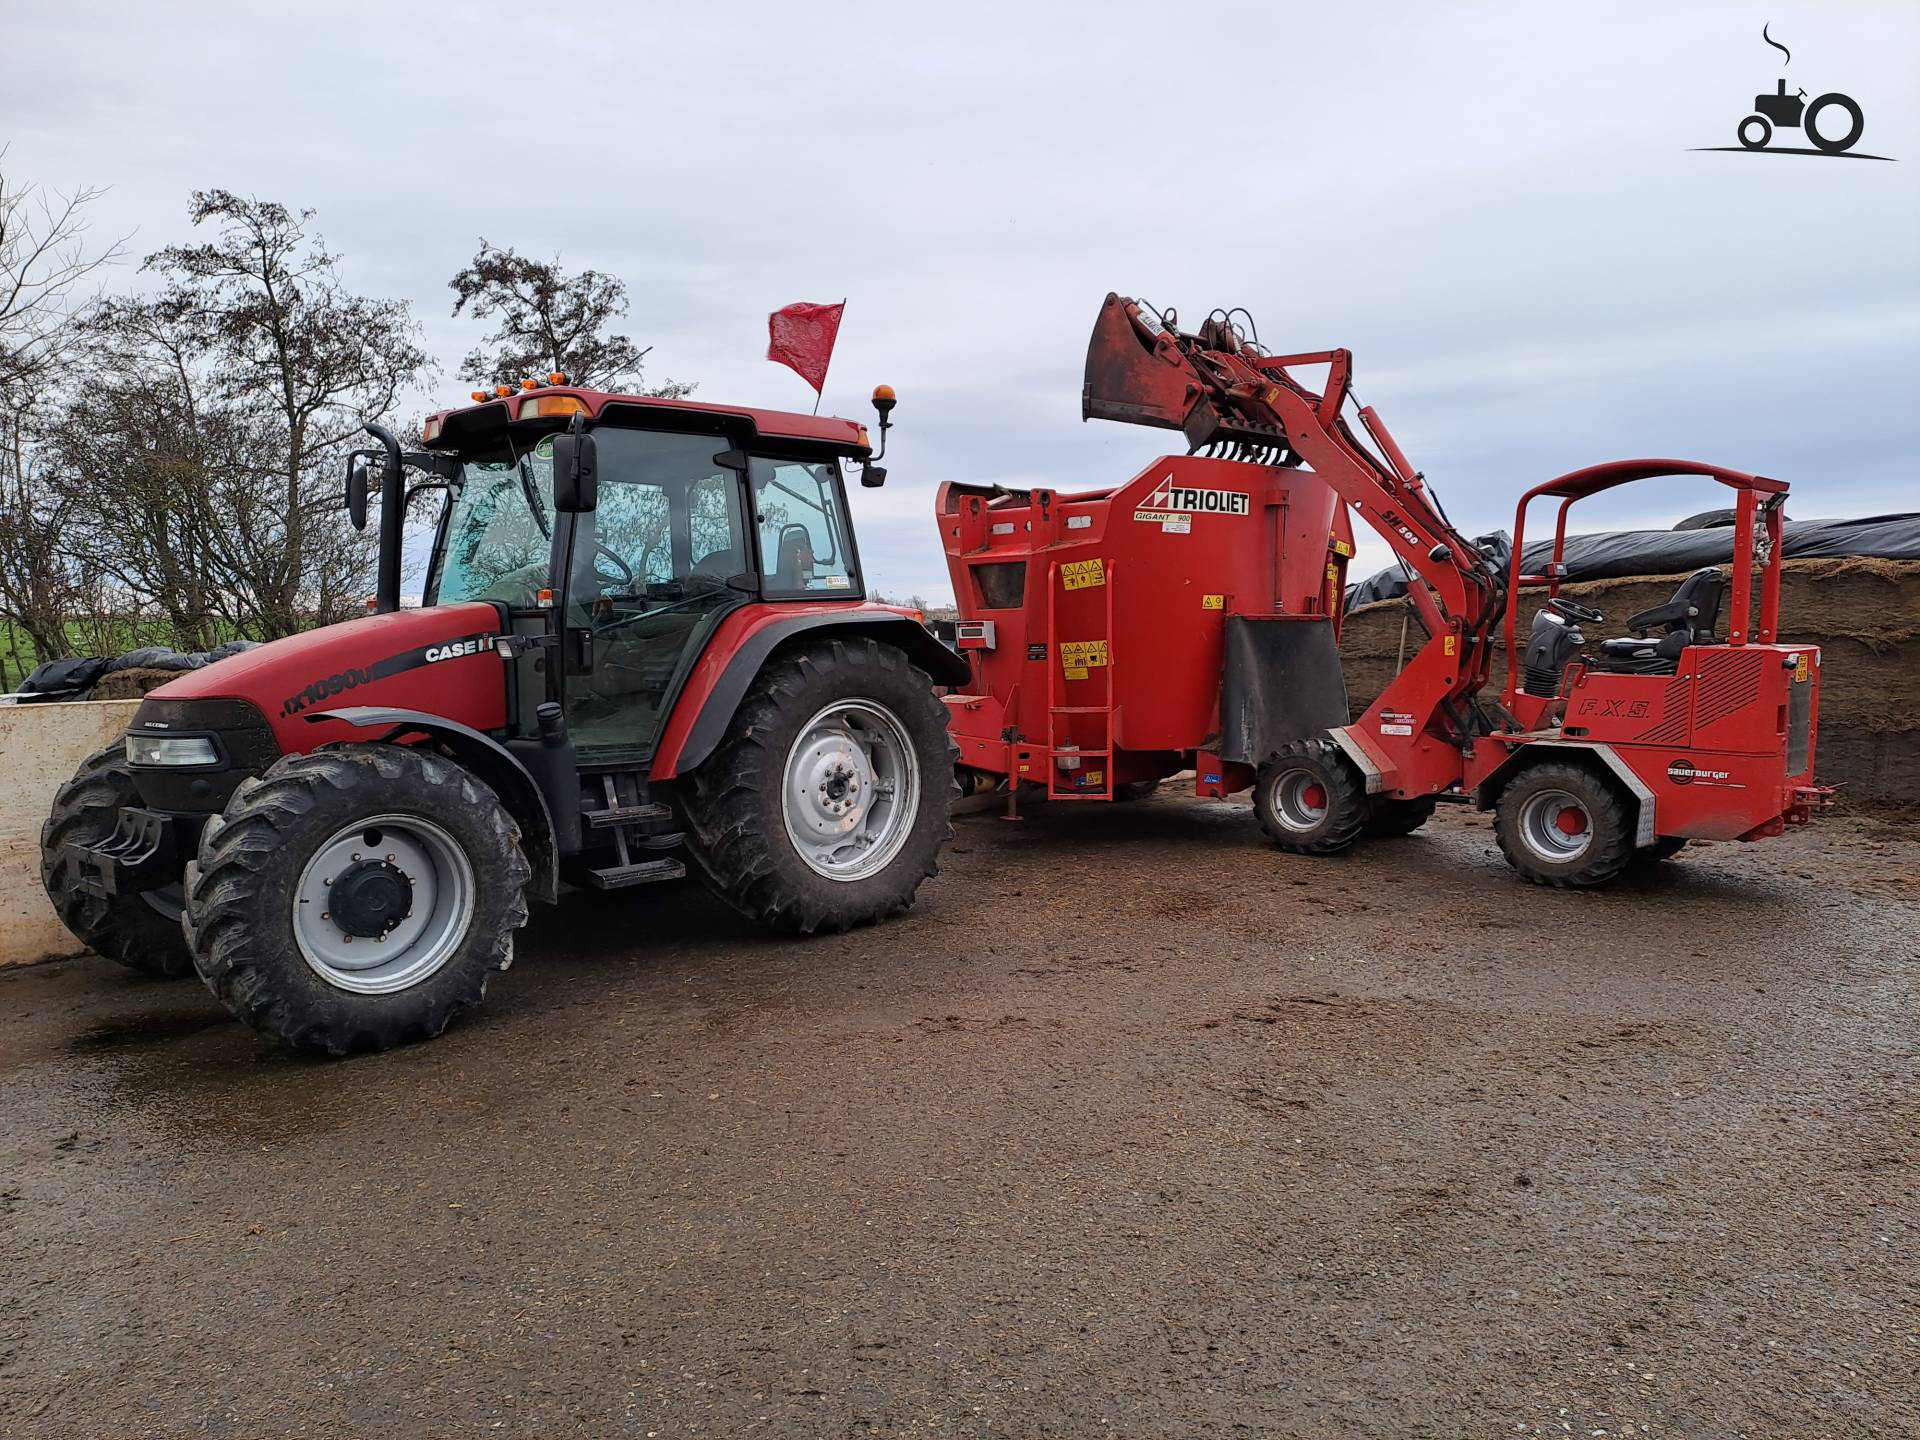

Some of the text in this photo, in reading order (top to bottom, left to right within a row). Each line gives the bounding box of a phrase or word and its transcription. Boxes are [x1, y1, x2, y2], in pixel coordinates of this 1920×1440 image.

[1170, 488, 1249, 513] TRIOLIET
[1135, 512, 1170, 521] GIGANT
[1398, 526, 1419, 544] 500
[425, 640, 476, 662] CASE
